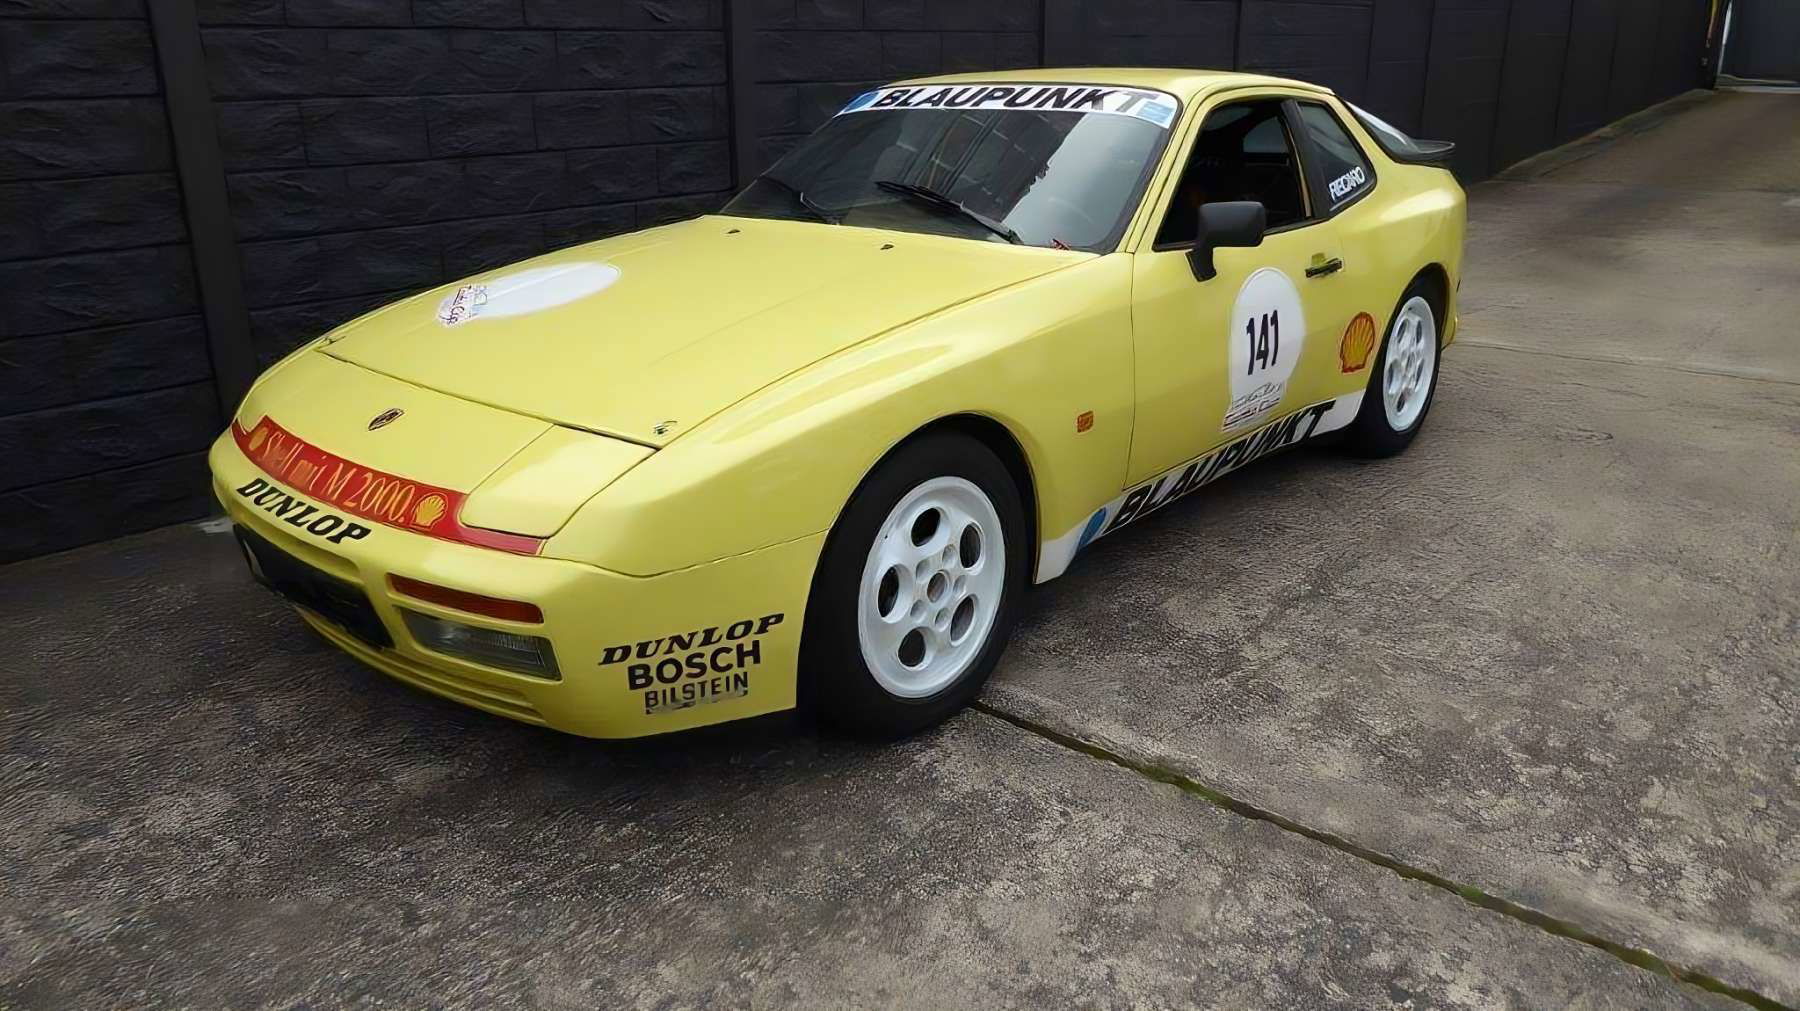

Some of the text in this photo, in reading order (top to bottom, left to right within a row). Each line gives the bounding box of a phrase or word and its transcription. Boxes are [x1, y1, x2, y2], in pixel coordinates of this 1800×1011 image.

[870, 86, 1158, 112] BLAUPUNKT
[1246, 309, 1279, 375] 141
[1101, 398, 1337, 536] BLAUPUNKT
[236, 477, 372, 544] DUNLOP
[597, 612, 785, 666] DUNLOP
[627, 640, 761, 690] BOSCH
[644, 671, 748, 710] BILSTEIN
